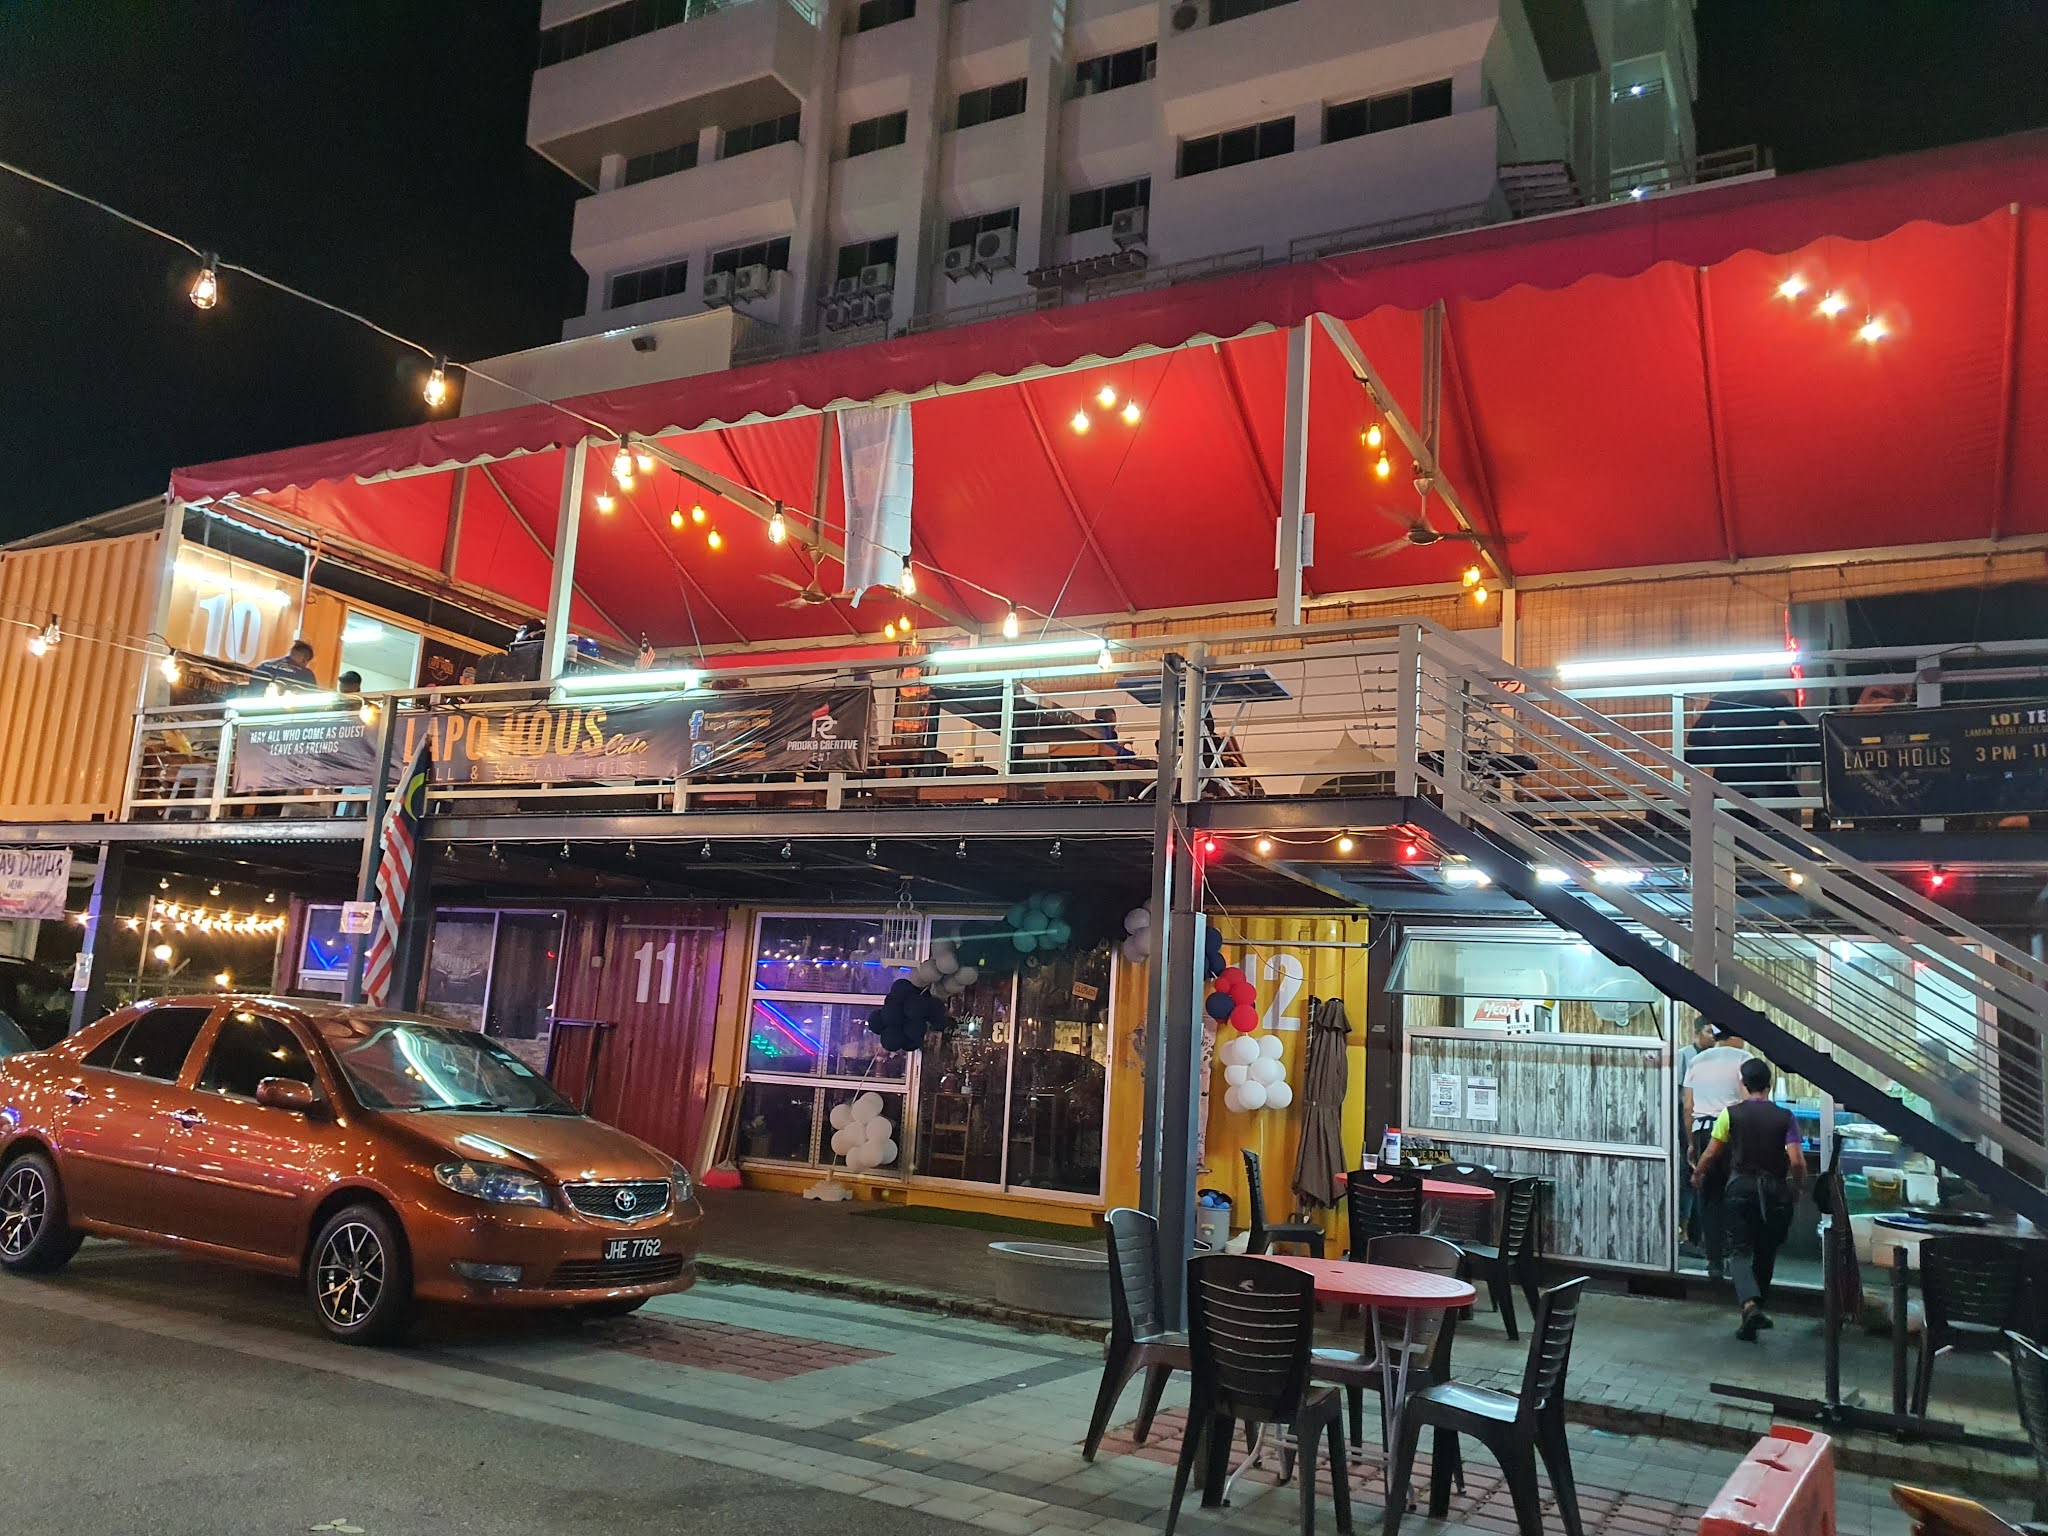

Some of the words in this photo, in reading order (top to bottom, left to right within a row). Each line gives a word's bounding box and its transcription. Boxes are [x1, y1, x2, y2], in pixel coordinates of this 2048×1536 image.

[200, 594, 262, 665] 10
[1990, 711, 2021, 726] LOT
[2027, 709, 2048, 724] TE
[250, 731, 267, 743] MAY
[267, 730, 281, 742] ALL
[282, 728, 300, 741] WHO
[302, 727, 325, 740] COME
[326, 726, 337, 739] AS
[338, 725, 366, 738] GUEST
[403, 715, 490, 763] LAPO
[270, 743, 293, 756] LEAVE
[293, 742, 304, 755] AS
[819, 739, 859, 750] CREATIVE
[1976, 747, 1986, 762] 3
[1992, 745, 2016, 760] PM
[1844, 750, 1888, 769] LAPO
[1898, 747, 1951, 767] HOUS
[470, 767, 479, 780] &
[634, 942, 676, 1004] 11
[605, 1240, 627, 1260] JHE
[631, 1238, 661, 1258] 7762
